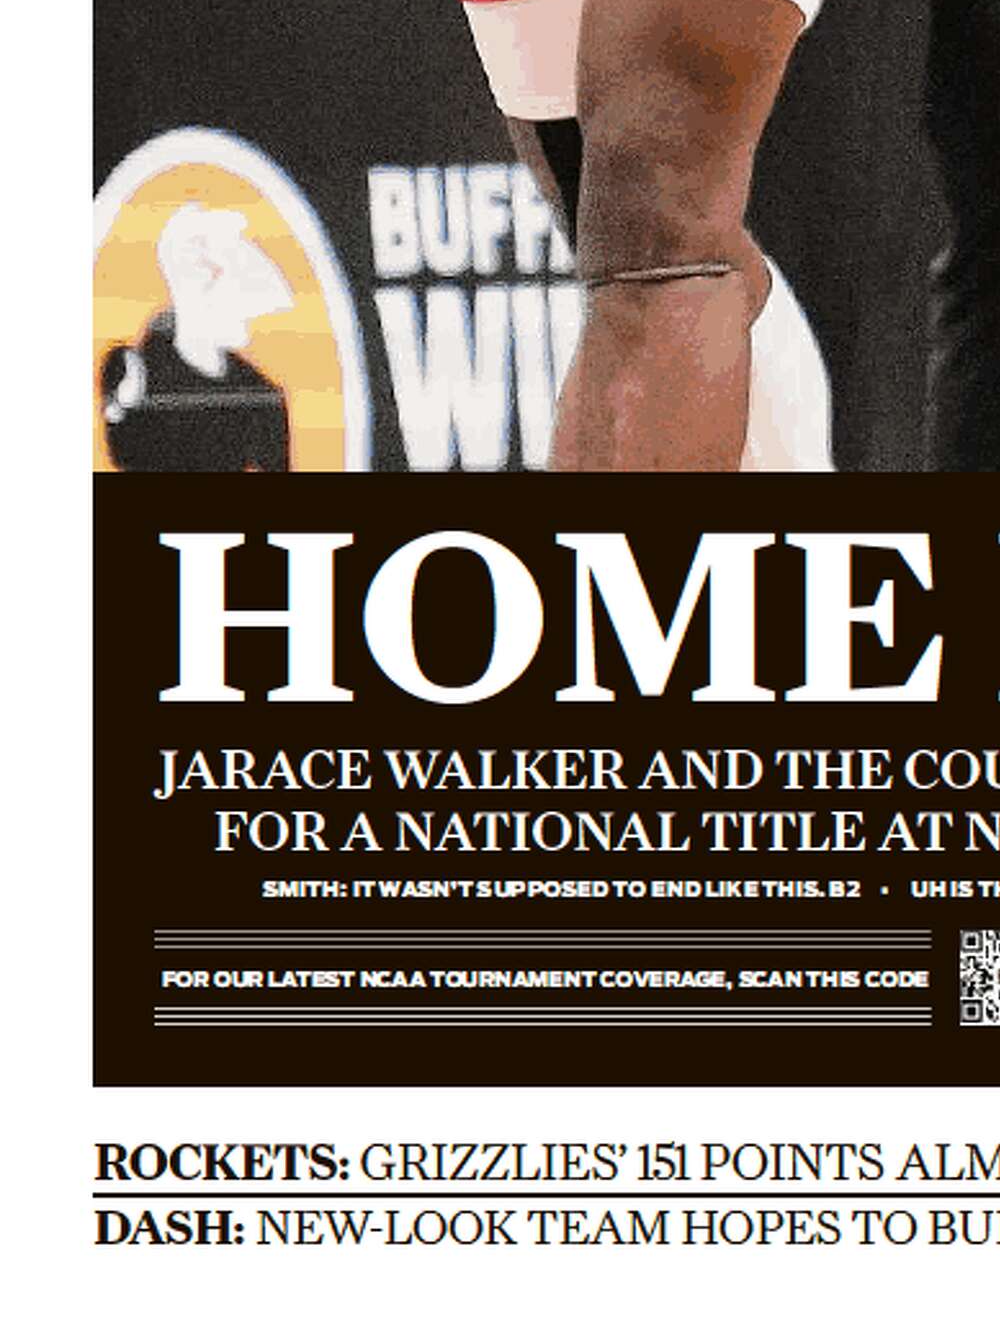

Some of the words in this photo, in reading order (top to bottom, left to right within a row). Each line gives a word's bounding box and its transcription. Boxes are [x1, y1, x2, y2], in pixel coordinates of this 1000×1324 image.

[159, 531, 943, 704] HOME
[153, 750, 371, 799] JARACE
[384, 750, 628, 790] WALKER
[638, 750, 763, 790] AND
[775, 750, 893, 790] THE
[216, 811, 330, 851] FOR
[340, 811, 383, 851] A
[396, 811, 690, 851] NATIONAL
[702, 811, 866, 851] TITLE
[877, 811, 953, 851] AT
[263, 880, 348, 898] SMITH:
[352, 880, 376, 898] IT
[378, 880, 474, 898] WASN'T
[476, 880, 609, 898] SUPPOSED
[612, 880, 646, 898] TO
[651, 880, 702, 898] END
[705, 880, 759, 898] LIKE
[762, 880, 826, 898] THIS.
[829, 880, 860, 898] B2
[911, 880, 947, 898] UH
[950, 880, 974, 898] IS
[162, 970, 210, 988] FOR
[213, 970, 265, 988] OUR
[268, 970, 356, 988] LATEST
[360, 970, 427, 988] NCAA
[430, 970, 598, 988] TOURNAMENT
[600, 970, 733, 991] COVERAGE,
[738, 970, 802, 988] SCAN
[805, 970, 860, 988] THIS
[864, 970, 930, 988] CODE
[95, 1143, 349, 1180] ROCKETS:
[638, 1143, 691, 1180] 151
[701, 1143, 883, 1180] POINTS
[95, 1210, 244, 1245] DASH:
[257, 1210, 517, 1245] NEW-LOOK
[528, 1210, 669, 1245] TEAM
[683, 1210, 841, 1245] HOPES
[852, 1210, 917, 1245] TO
